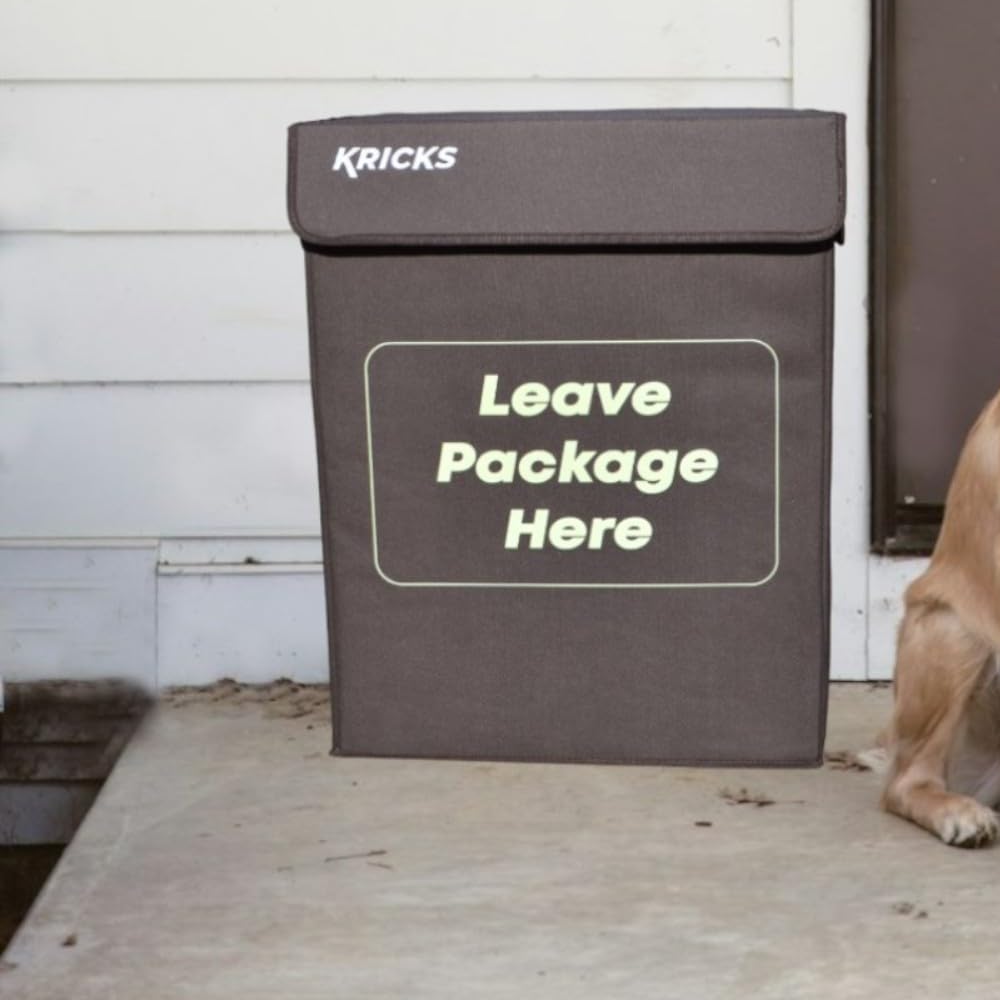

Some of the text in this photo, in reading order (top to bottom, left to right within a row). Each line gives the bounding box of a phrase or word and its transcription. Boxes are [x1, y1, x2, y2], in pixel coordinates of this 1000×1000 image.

[332, 145, 459, 179] KRICKS
[478, 374, 672, 417] Leave
[436, 439, 719, 495] Package
[504, 508, 653, 550] Here
